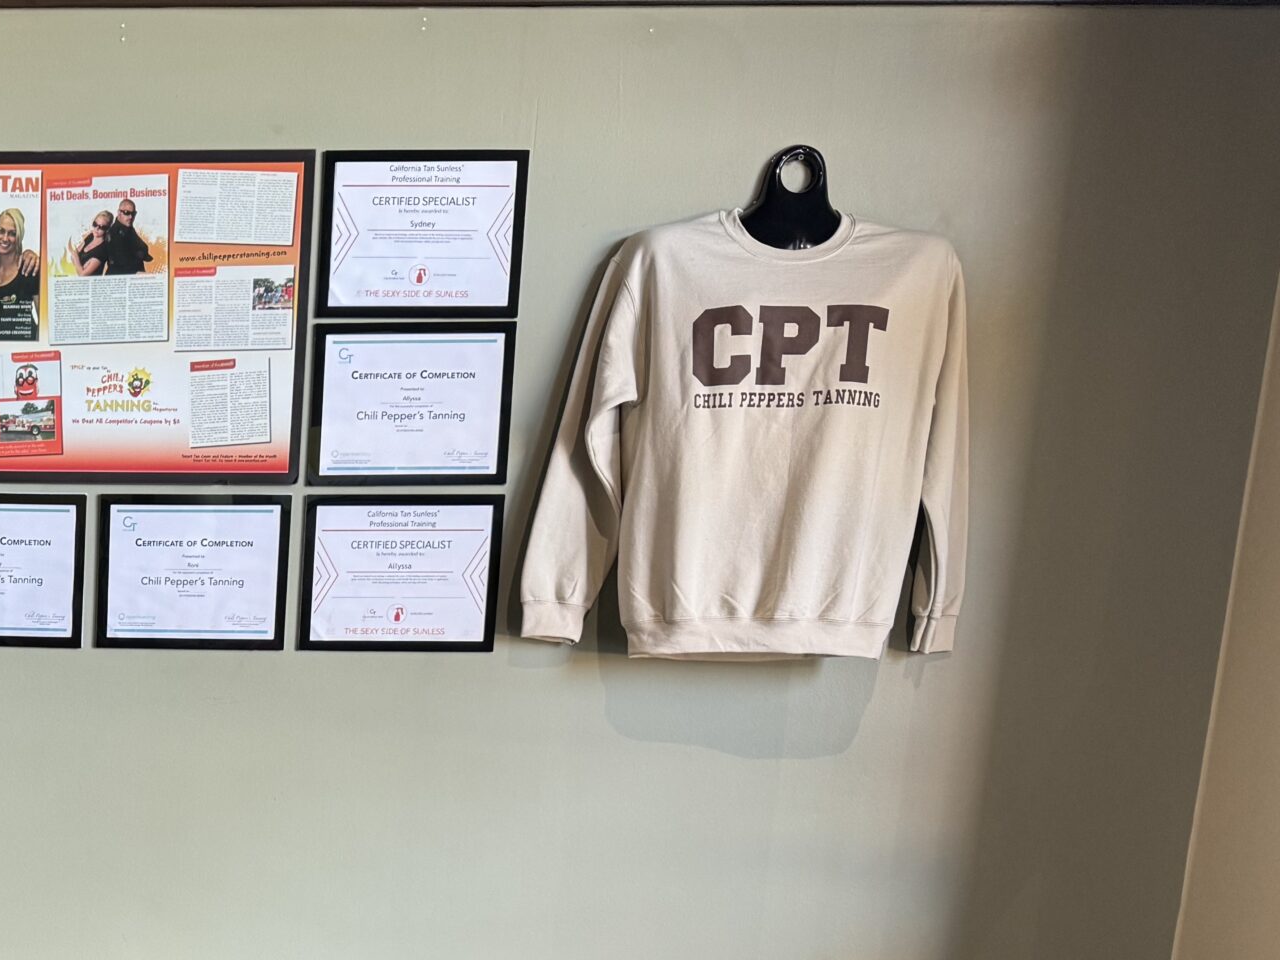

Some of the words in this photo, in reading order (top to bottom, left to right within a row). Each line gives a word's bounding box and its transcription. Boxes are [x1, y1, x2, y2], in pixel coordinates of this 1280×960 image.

[390, 164, 421, 172] California
[392, 175, 432, 183] Professional
[434, 175, 460, 184] Training
[50, 191, 64, 201] Hot
[93, 189, 128, 199] Booming
[130, 188, 167, 198] Business
[372, 196, 420, 206] CERTIFIED
[423, 196, 477, 206] SPECIALIST
[410, 220, 435, 228] Sydney
[179, 250, 287, 262] www.chilipepperstanning.com
[435, 290, 469, 298] SUNLESS
[693, 304, 890, 386] CPT
[101, 373, 124, 384] CHILI
[351, 370, 402, 380] CERTIFICATE
[420, 370, 475, 379] COMPLETION
[86, 384, 123, 397] PEPPERS
[694, 392, 733, 409] CHILI
[740, 391, 805, 408] PEPPERS
[813, 389, 880, 409] TANNING
[85, 399, 152, 412] TANNING
[356, 411, 378, 421] Chili
[381, 411, 424, 422] Pepper's
[427, 411, 465, 422] Tanning
[0, 536, 51, 547] COMPLETION
[135, 538, 183, 547] CERTIFICATE
[200, 538, 253, 548] COMPLETION
[351, 540, 397, 550] CERTIFIED
[399, 540, 452, 549] SPECIALIST
[8, 575, 43, 586] Tanning
[141, 577, 161, 585] Chili
[164, 577, 205, 588] Pepper's
[208, 577, 244, 588] Tanning
